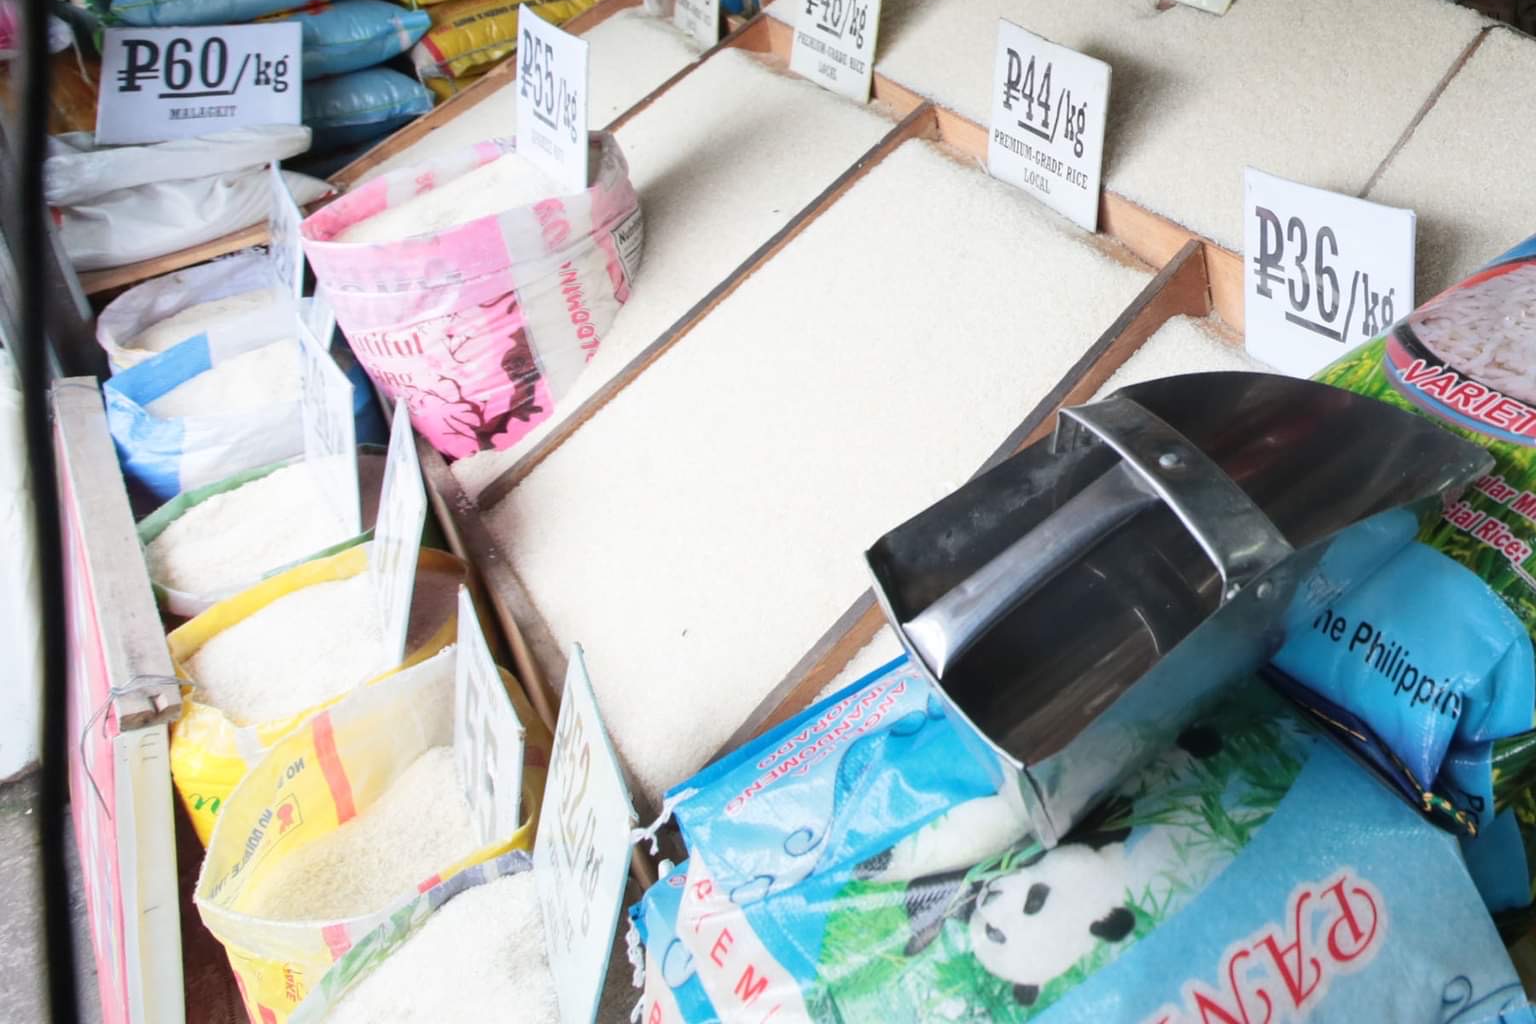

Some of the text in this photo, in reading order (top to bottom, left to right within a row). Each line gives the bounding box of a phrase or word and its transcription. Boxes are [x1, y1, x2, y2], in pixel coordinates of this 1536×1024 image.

[117, 35, 290, 95] ₱60/kg
[520, 27, 578, 145] ₱55/kg
[1002, 47, 1089, 160] ₱44/kg
[993, 127, 1089, 192] PREMIUM-GRADE RICE
[1023, 166, 1051, 196] LOCAL
[1474, 471, 1518, 511] ular
[1475, 515, 1534, 567] Rice:
[1347, 619, 1464, 722] Philippin
